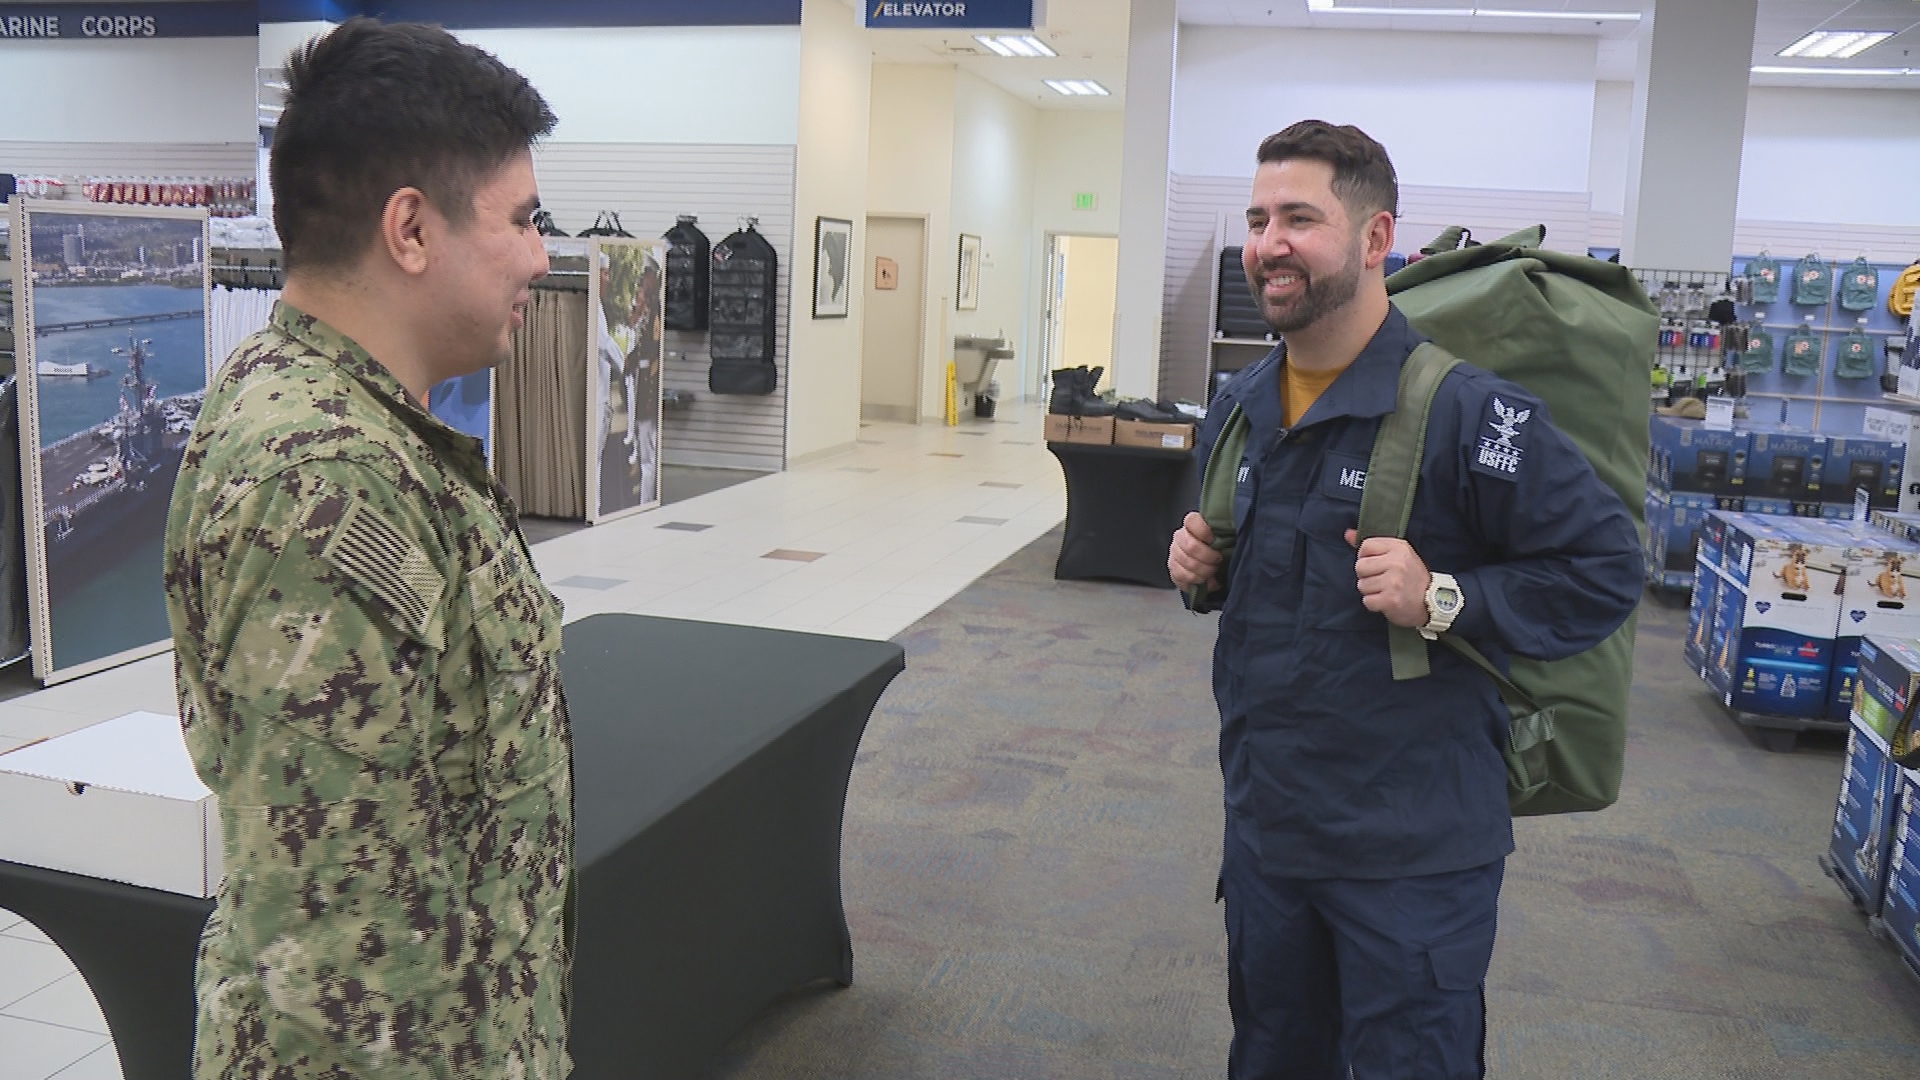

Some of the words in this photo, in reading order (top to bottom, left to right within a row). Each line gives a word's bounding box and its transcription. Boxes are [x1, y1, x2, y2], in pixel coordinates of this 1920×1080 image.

[81, 16, 156, 37] CORPS
[1478, 449, 1518, 473] USFFC
[1340, 467, 1368, 490] ME
